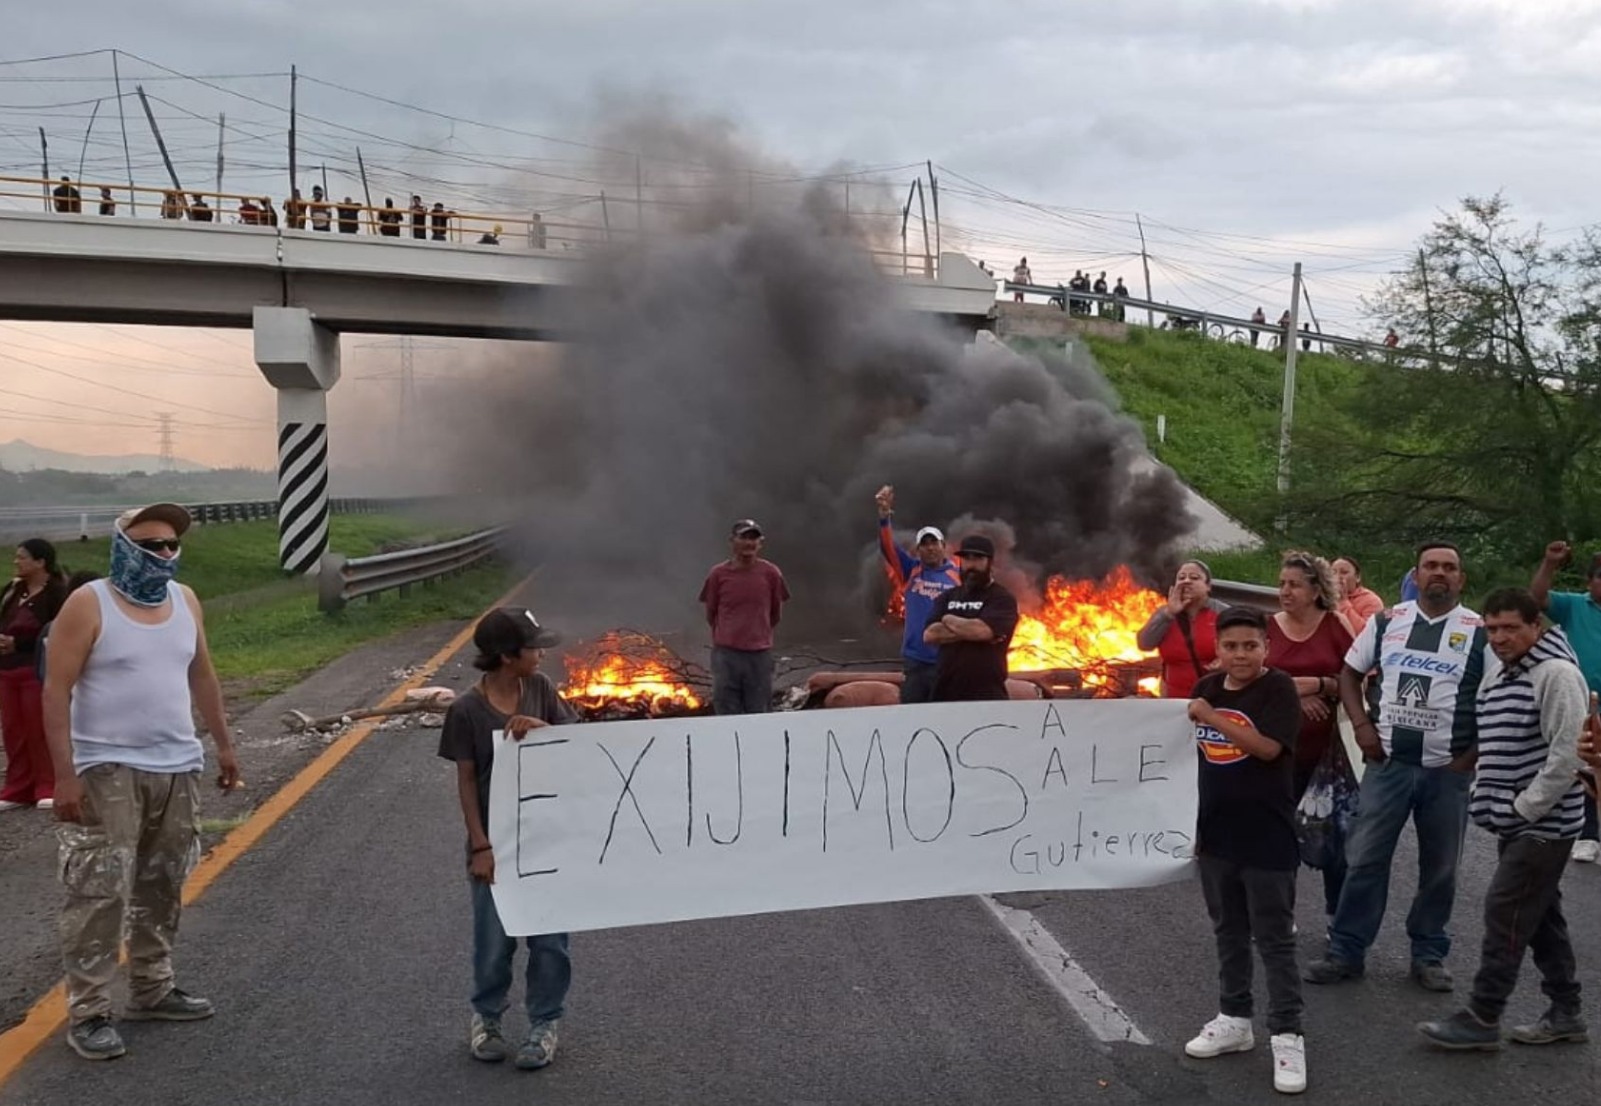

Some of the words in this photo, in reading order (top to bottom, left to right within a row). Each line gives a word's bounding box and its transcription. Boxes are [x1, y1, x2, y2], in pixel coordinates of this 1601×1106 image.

[1400, 654, 1459, 676] telcel
[1041, 703, 1066, 739] A
[516, 723, 1029, 878] EXIJIMOS
[1010, 810, 1199, 875] Gutierrez
